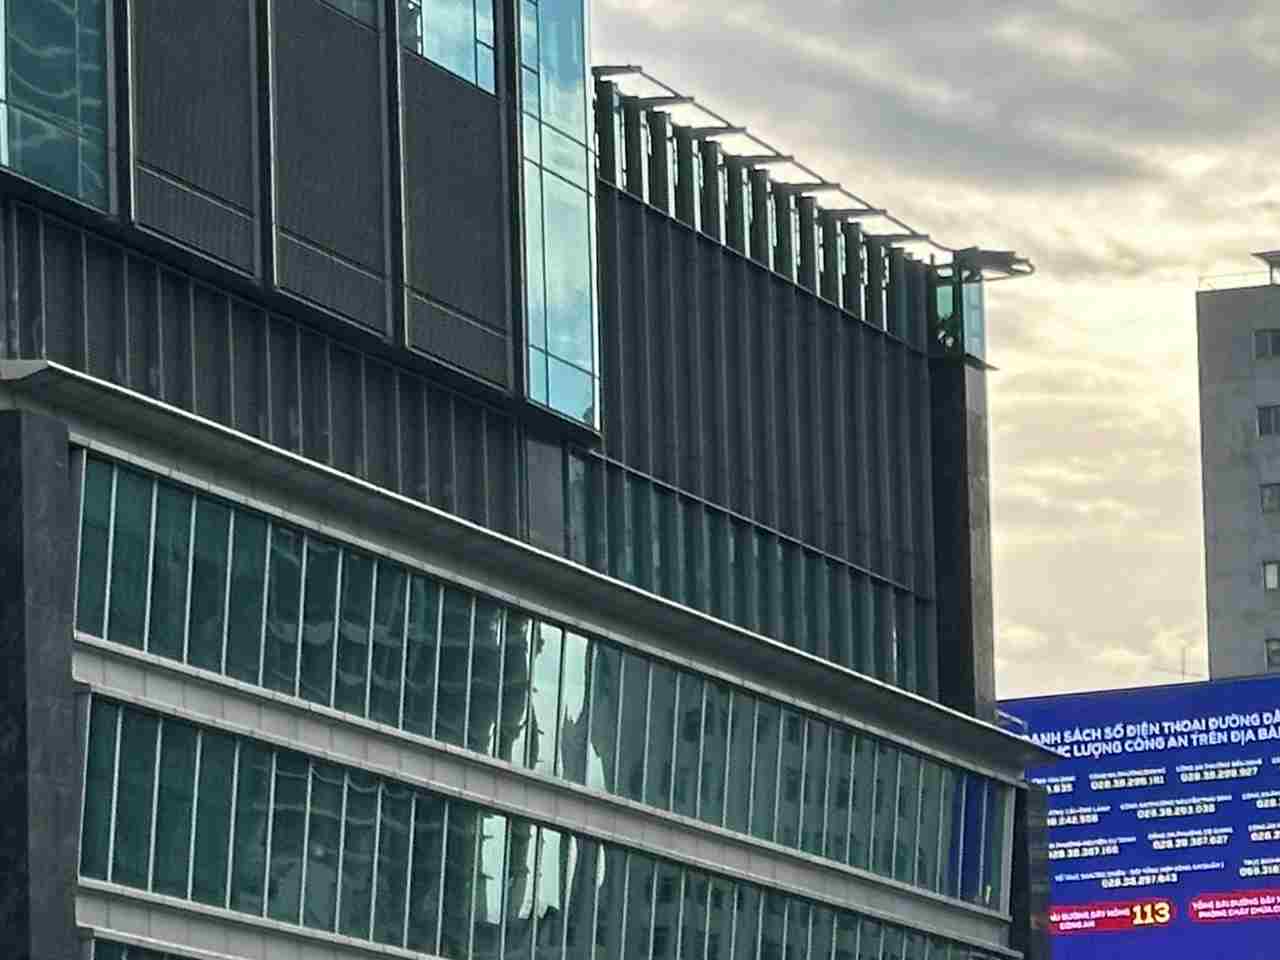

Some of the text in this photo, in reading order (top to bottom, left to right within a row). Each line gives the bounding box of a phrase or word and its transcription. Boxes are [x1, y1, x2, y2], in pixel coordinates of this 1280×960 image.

[1030, 731, 1062, 745] ANH
[1063, 726, 1101, 743] SÁCH
[1124, 737, 1165, 752] CÔNG
[1167, 735, 1189, 749] AN
[1132, 902, 1170, 925] 113
